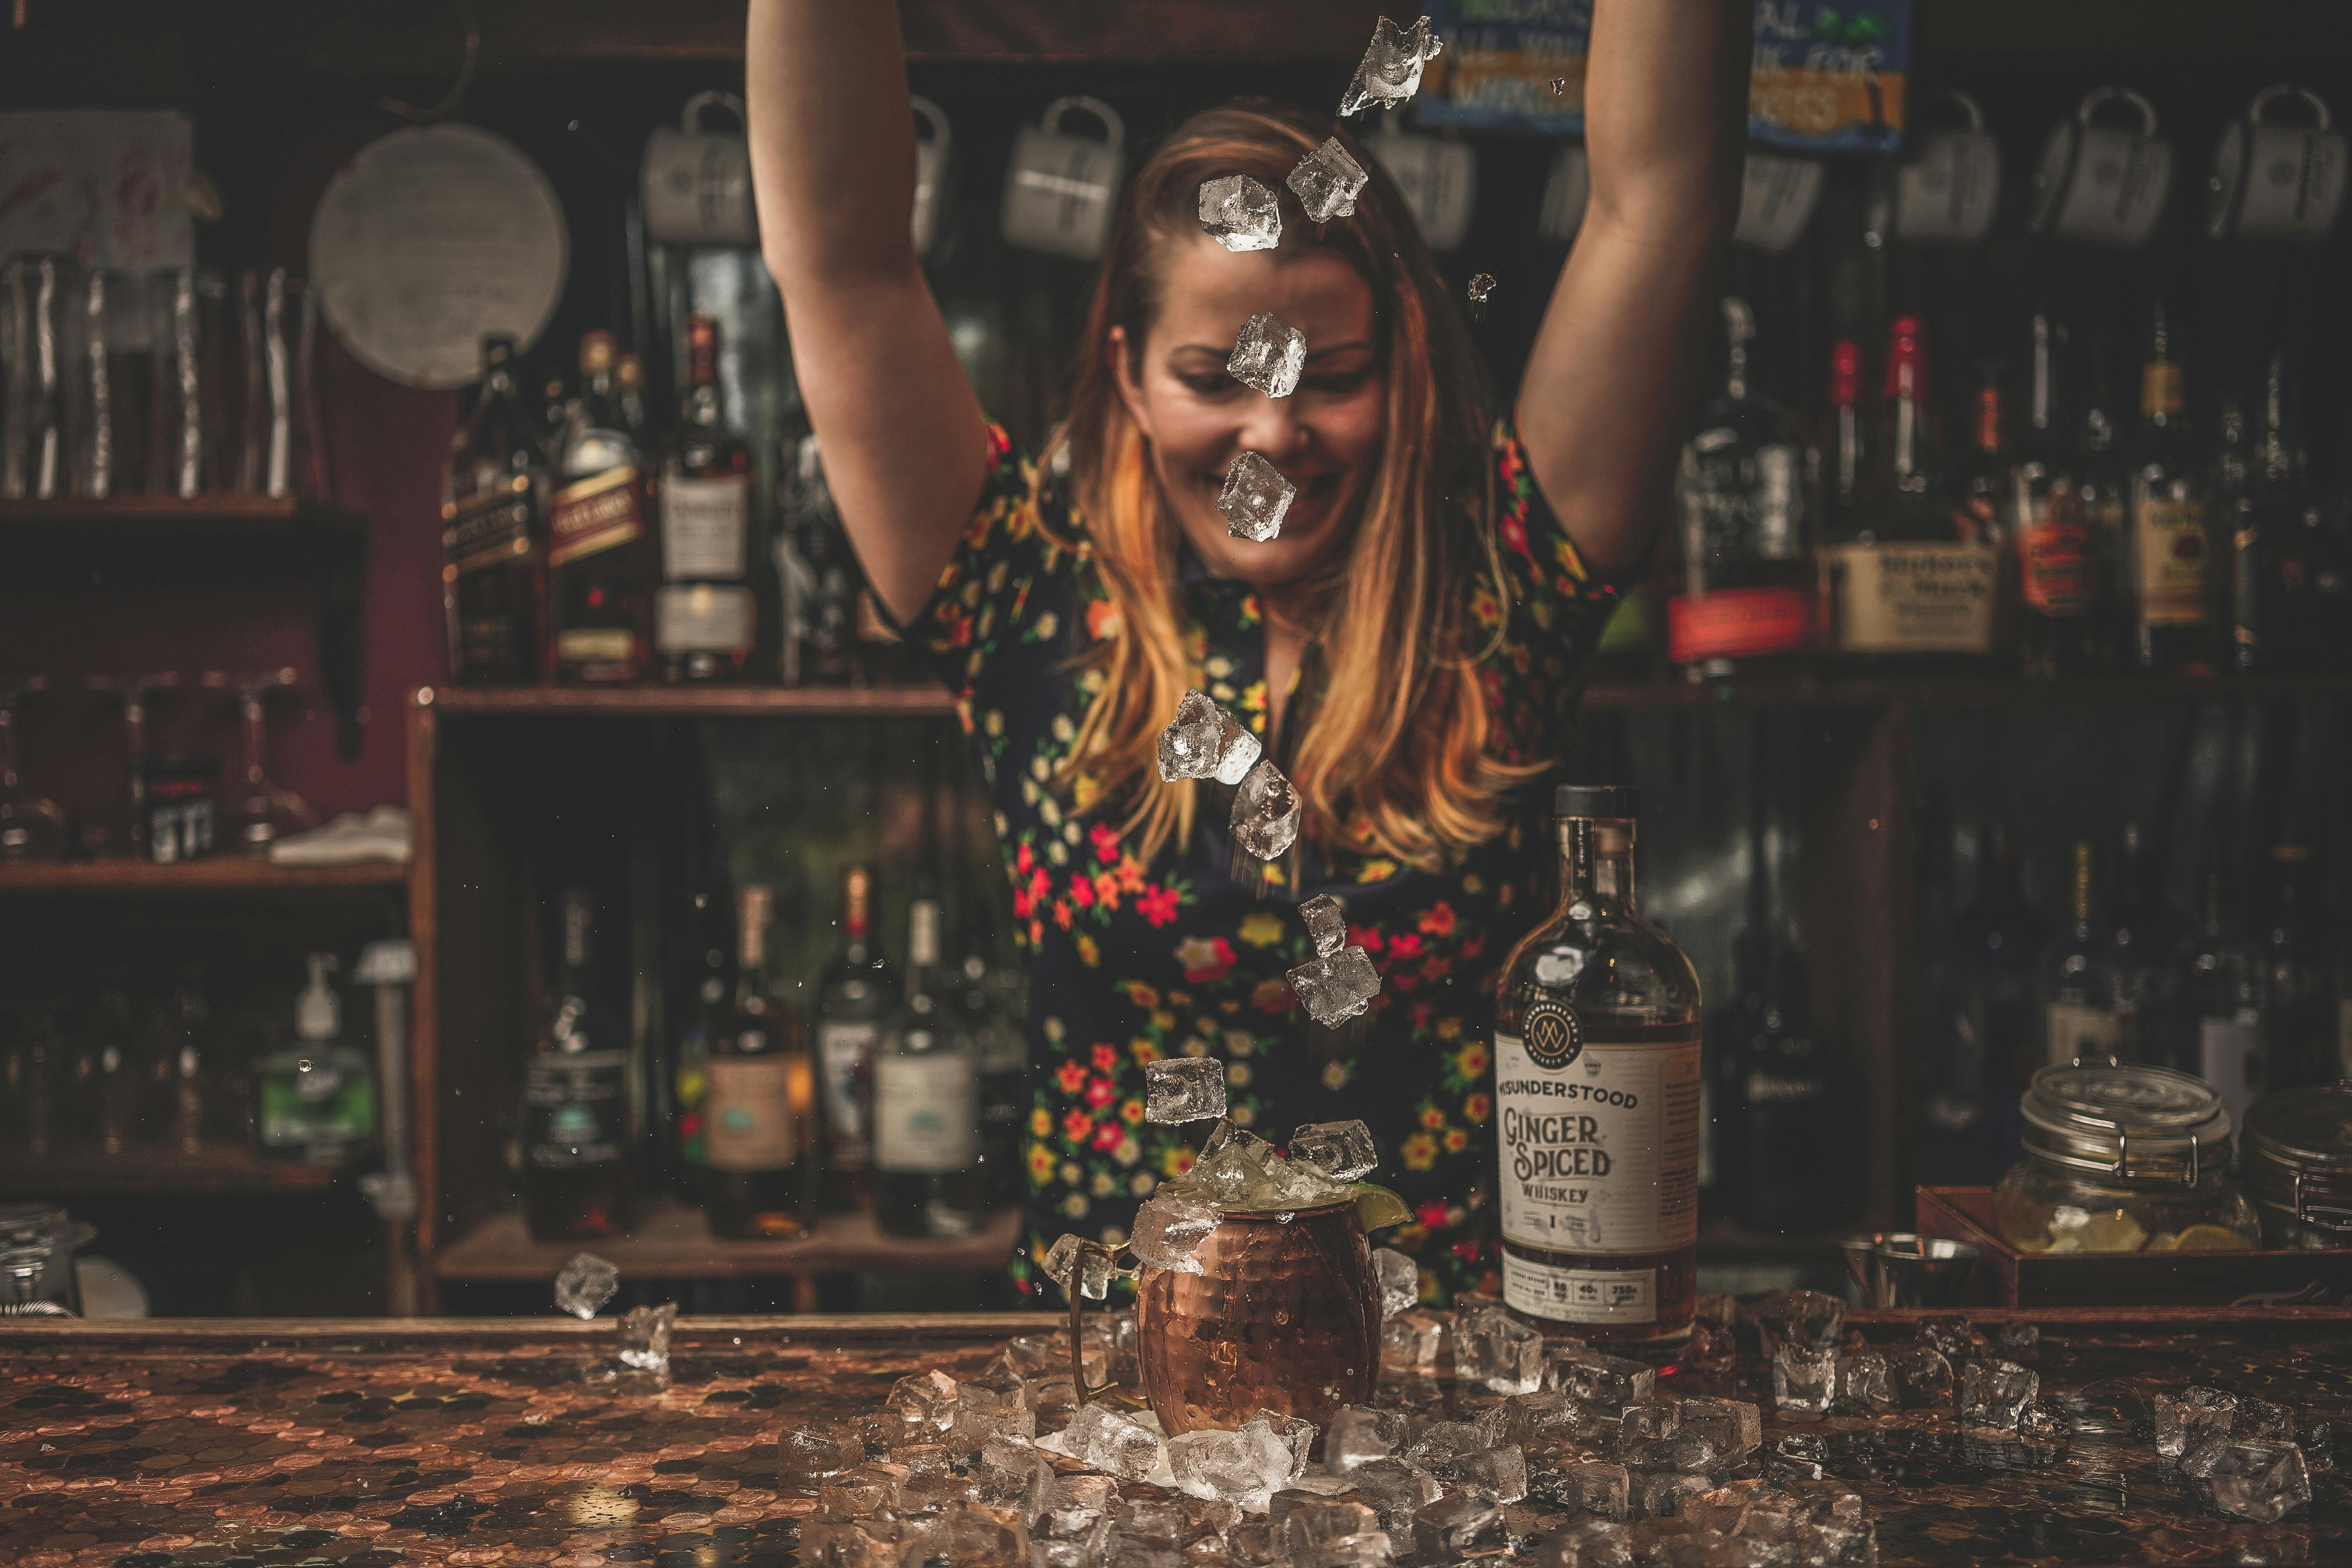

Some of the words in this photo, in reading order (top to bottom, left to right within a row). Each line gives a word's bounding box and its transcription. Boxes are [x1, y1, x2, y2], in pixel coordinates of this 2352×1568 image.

[1500, 1080, 1638, 1109] MISUNDERSTOOD
[1504, 1108, 1598, 1146] GINGER
[1514, 1142, 1611, 1181] SPICED
[1522, 1183, 1589, 1204] WHISKEY
